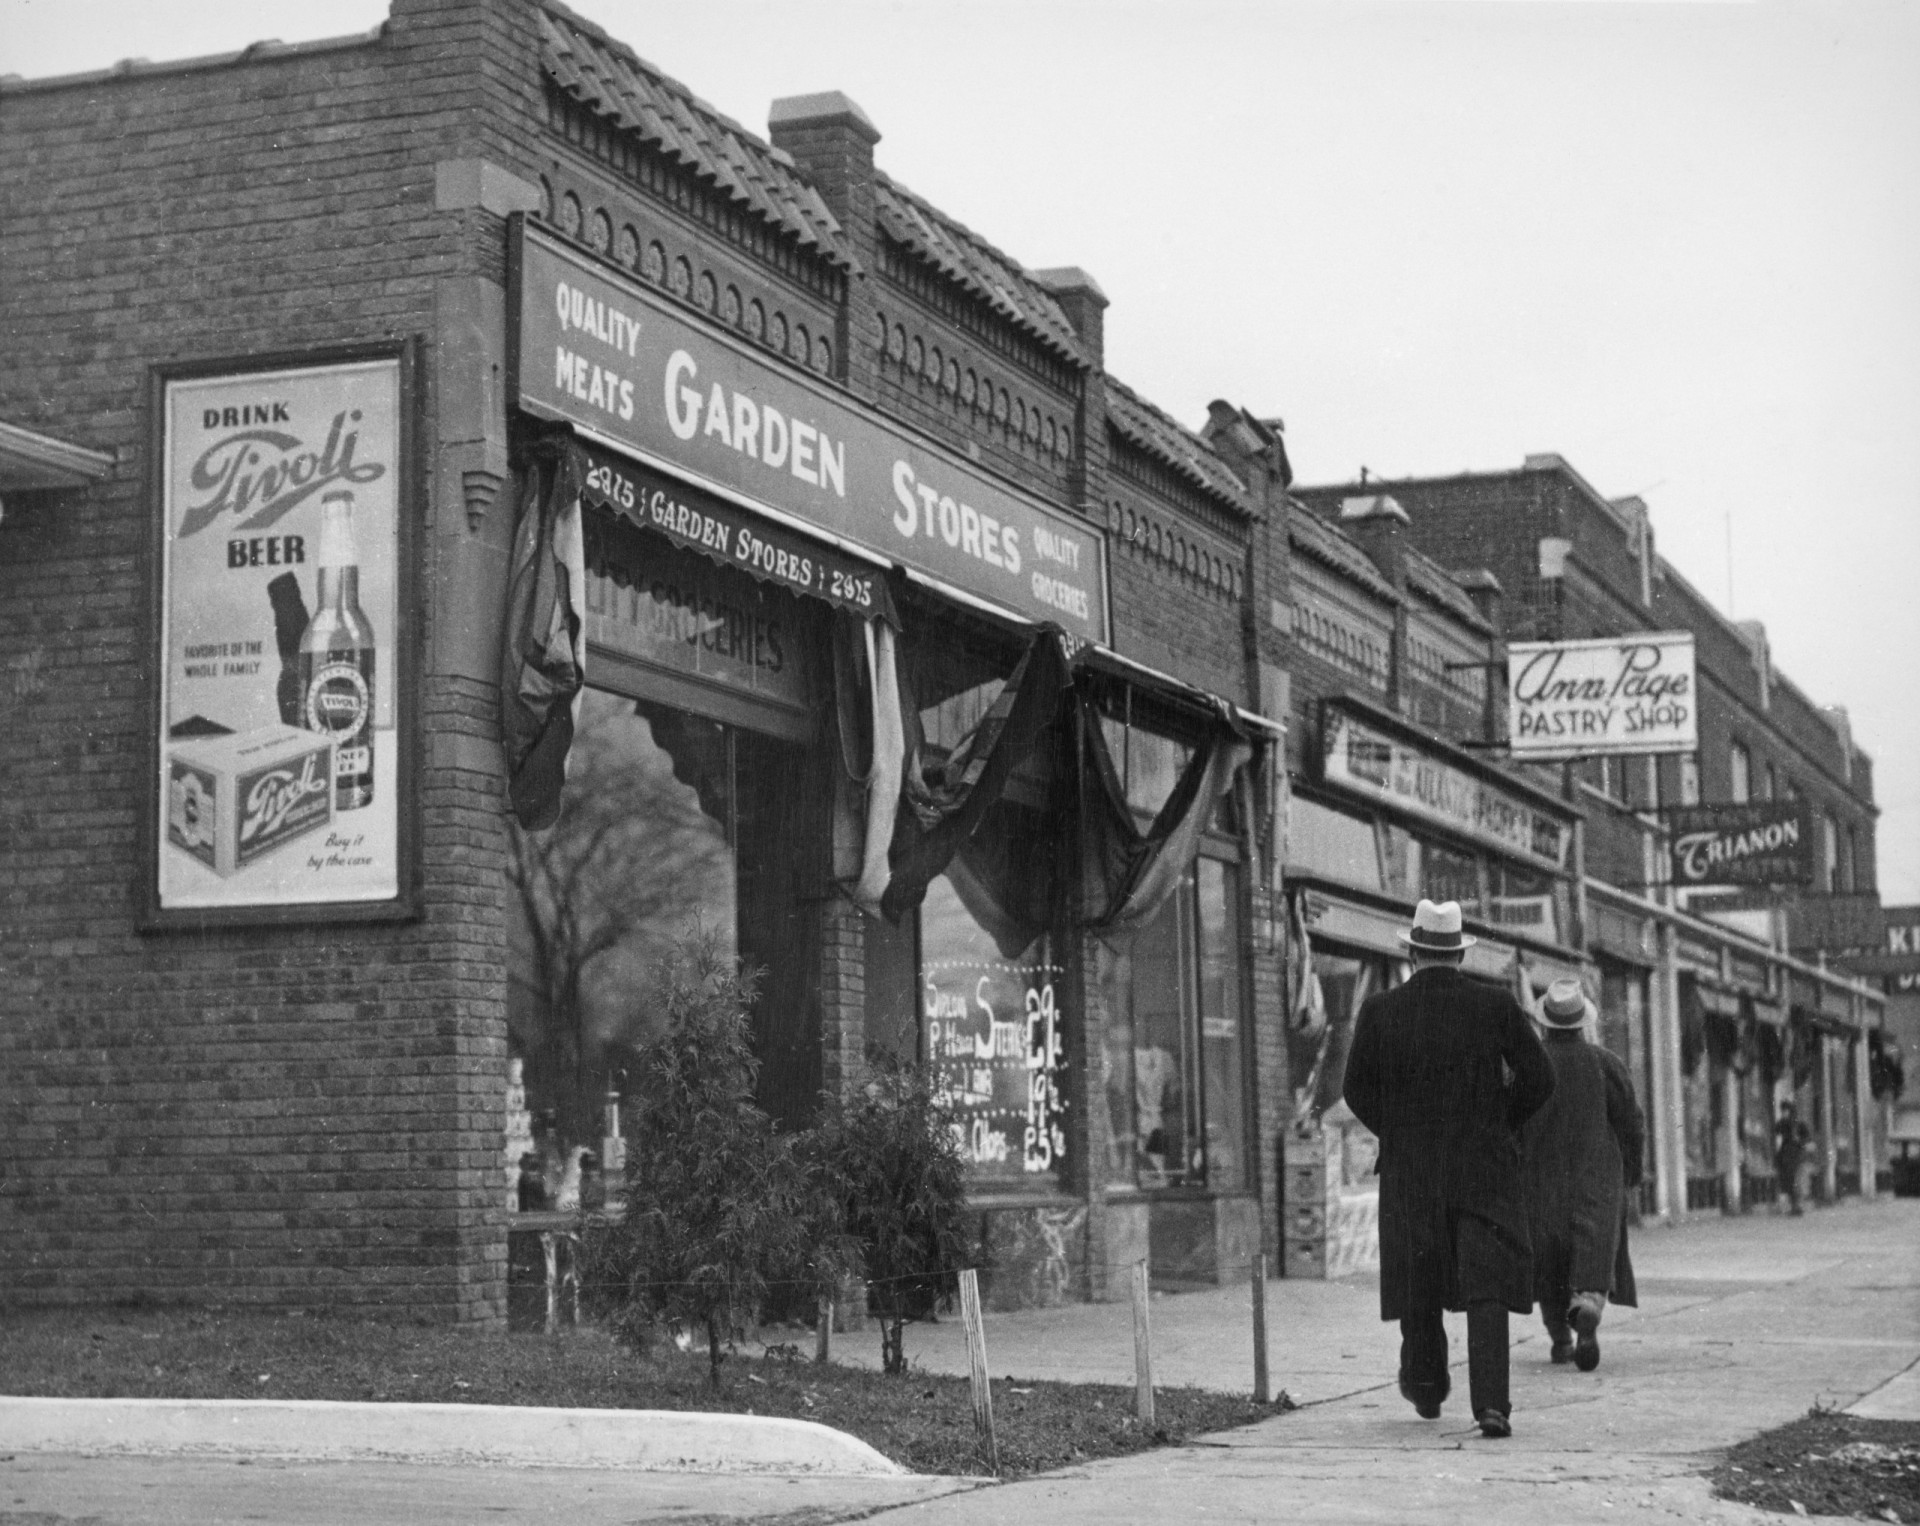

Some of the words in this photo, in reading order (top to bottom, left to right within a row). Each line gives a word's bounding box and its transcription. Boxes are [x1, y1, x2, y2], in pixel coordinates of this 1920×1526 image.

[555, 281, 641, 358] QUALITY
[554, 346, 635, 421] MEATS
[203, 401, 290, 430] DRINK
[177, 409, 386, 539] Tivoli
[663, 349, 847, 499] GARDEN
[891, 459, 1022, 574] STORES
[227, 536, 305, 568] BEER
[651, 491, 730, 553] GARDEN
[735, 528, 812, 586] STORES
[184, 663, 217, 678] WHOLE
[223, 661, 260, 676] FAMILY
[231, 642, 243, 657] OF
[245, 640, 262, 655] THE
[1514, 650, 1606, 705] Ann
[1609, 644, 1689, 705] Page
[1519, 708, 1614, 737] PASTRY
[1624, 703, 1689, 734] SHOP
[307, 855, 324, 872] by
[325, 854, 345, 866] the
[346, 856, 373, 866] case
[325, 833, 350, 852] Buy
[352, 834, 365, 847] it
[1674, 818, 1799, 879] TRIANON
